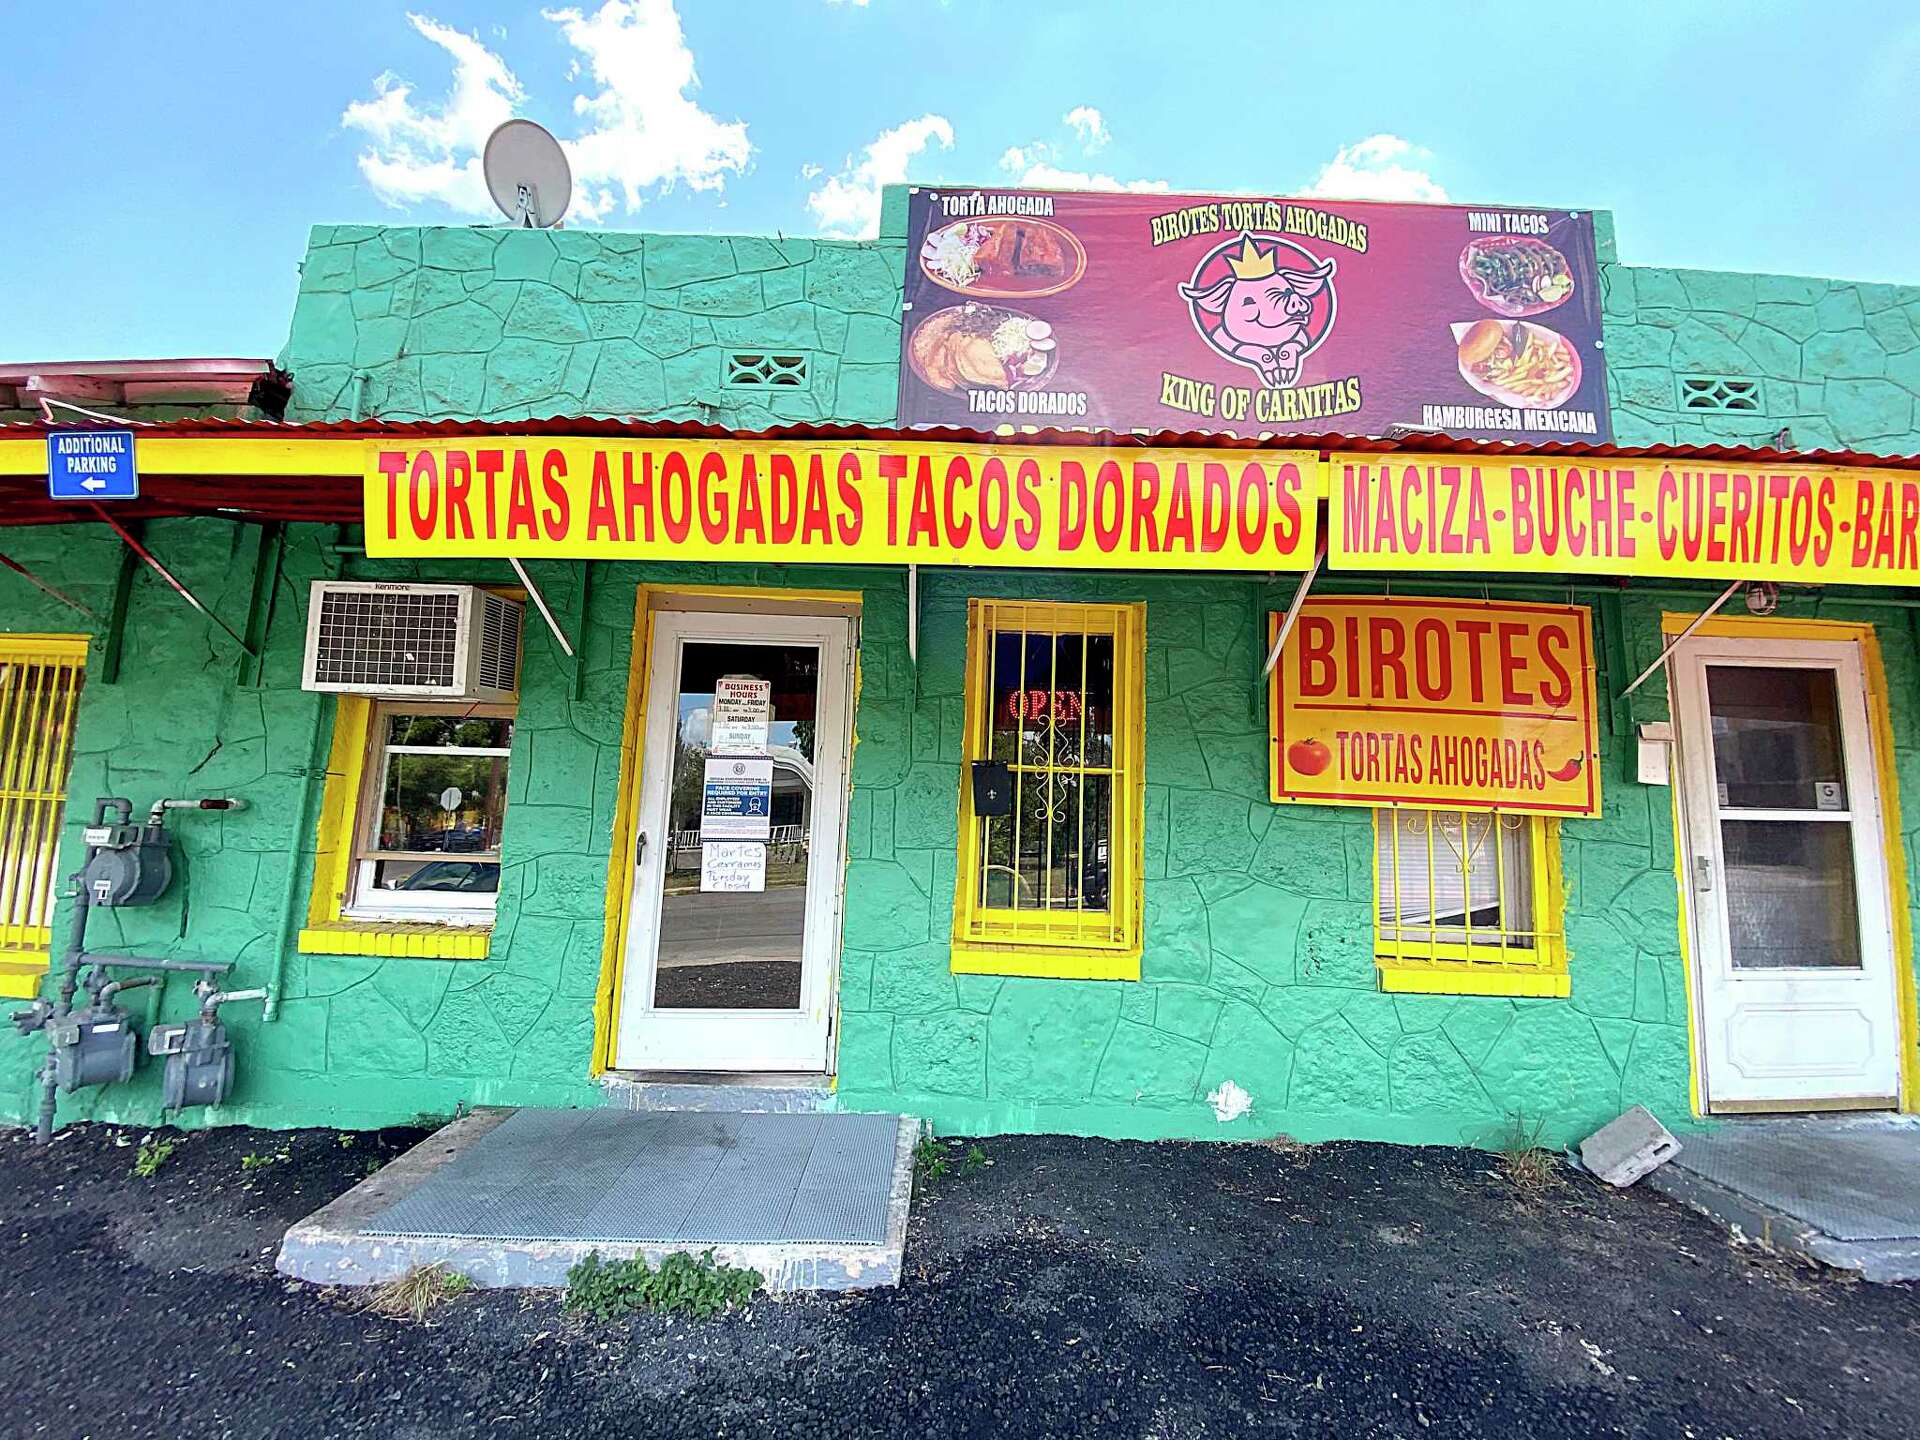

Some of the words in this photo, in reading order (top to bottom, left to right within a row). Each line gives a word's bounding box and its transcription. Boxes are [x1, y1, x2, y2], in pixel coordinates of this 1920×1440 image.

[942, 196, 985, 216] TORTA
[988, 197, 1054, 216] AHOGADA
[1151, 203, 1219, 246] BIROTES
[1222, 202, 1282, 232] TORTAS
[1284, 206, 1368, 253] AHOGADAS
[1468, 212, 1501, 233] MINI
[1503, 214, 1549, 234] TACOS
[968, 390, 1016, 413] TACOS
[1018, 392, 1087, 415] DORADOS
[1160, 373, 1216, 417] KING
[1221, 387, 1251, 421] OF
[1255, 377, 1361, 423] CARNITAS
[1423, 405, 1522, 431] HAMBURGESA
[1523, 410, 1598, 433] MEXICANA
[58, 437, 125, 454] ADDITIONAL
[67, 456, 117, 473] PARKING
[379, 449, 570, 540] TORTAS
[587, 451, 862, 546] AHOGADAS
[879, 455, 1041, 551] TACOS
[1058, 460, 1302, 555] DORADOS
[1300, 615, 1572, 708] BIROTES
[1009, 690, 1085, 720] OPEN
[1336, 731, 1423, 784] TORTAS
[1429, 735, 1546, 791] AHOGADAS
